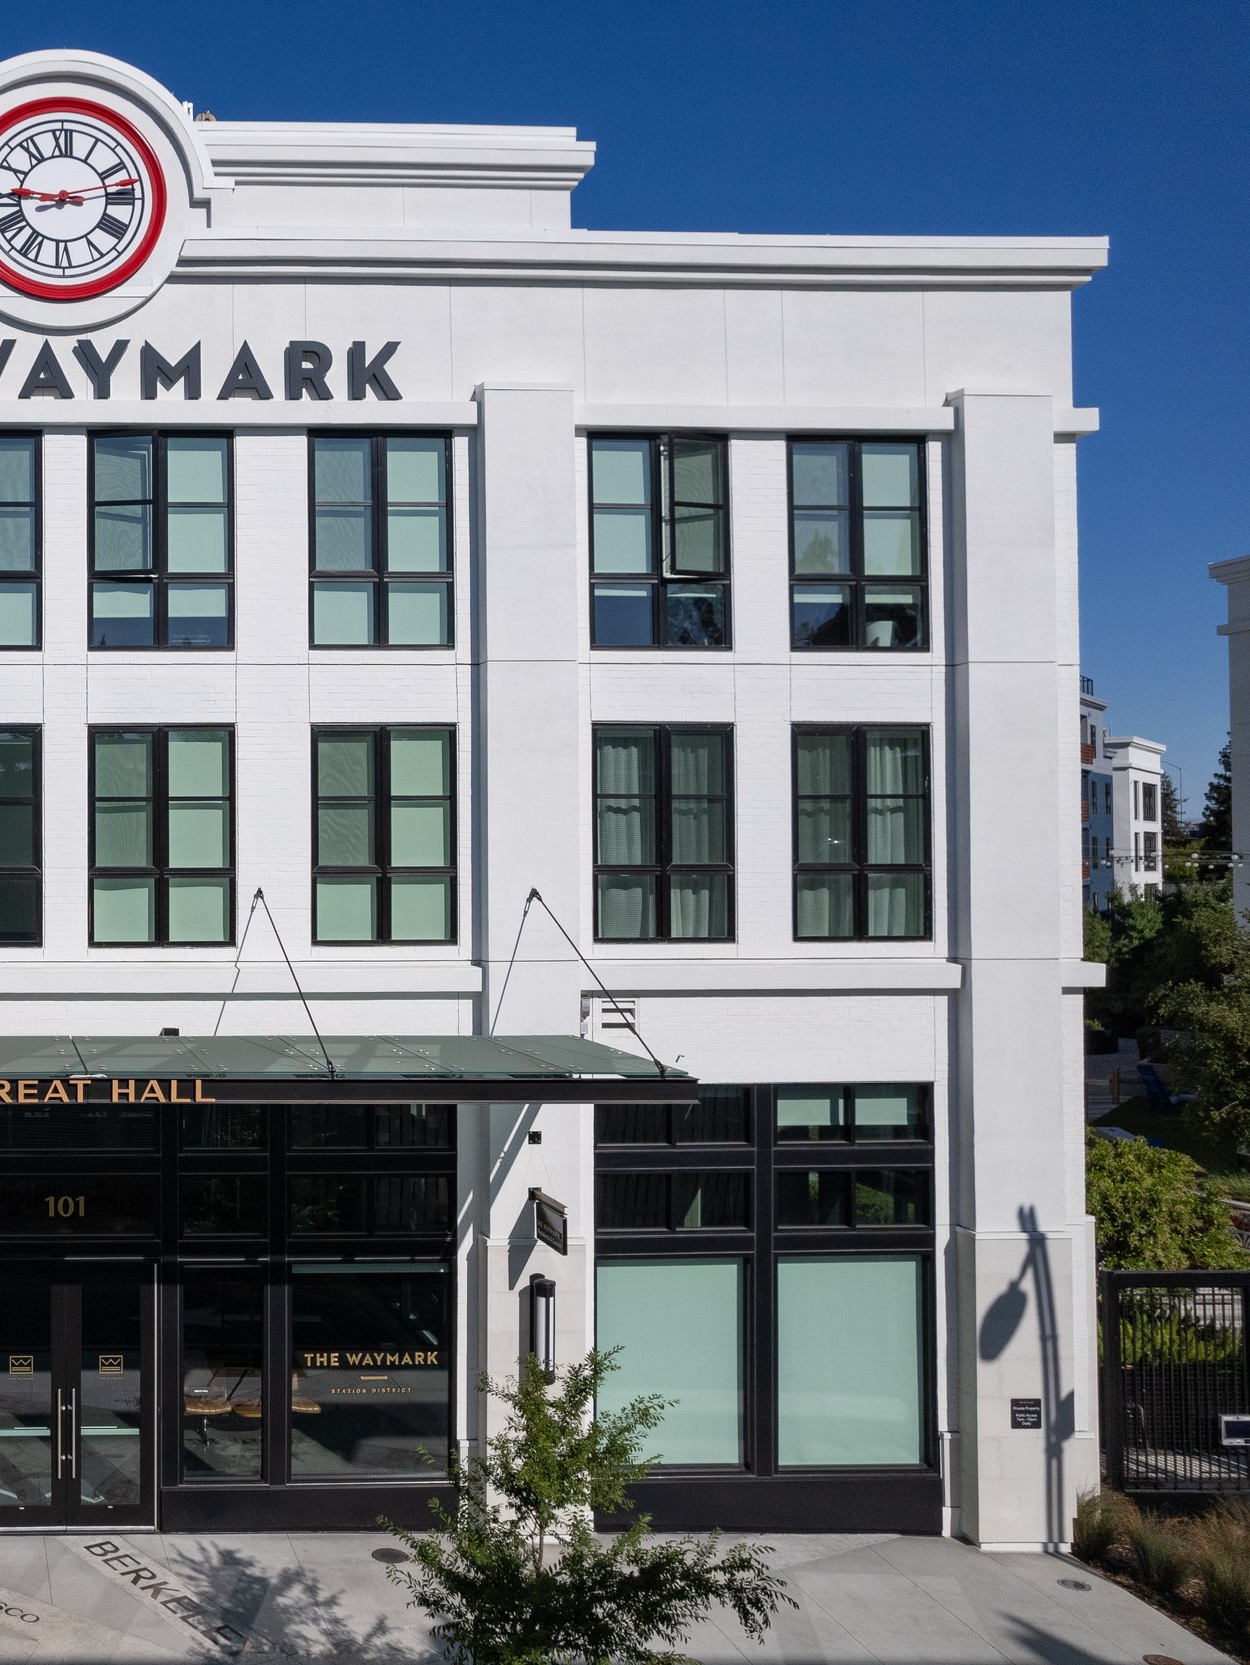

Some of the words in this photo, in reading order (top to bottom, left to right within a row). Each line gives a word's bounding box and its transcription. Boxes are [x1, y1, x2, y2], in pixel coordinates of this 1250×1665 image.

[111, 1079, 217, 1104] HALL
[45, 1195, 85, 1218] 101
[303, 1352, 340, 1367] THE
[345, 1351, 440, 1366] WAYMARK
